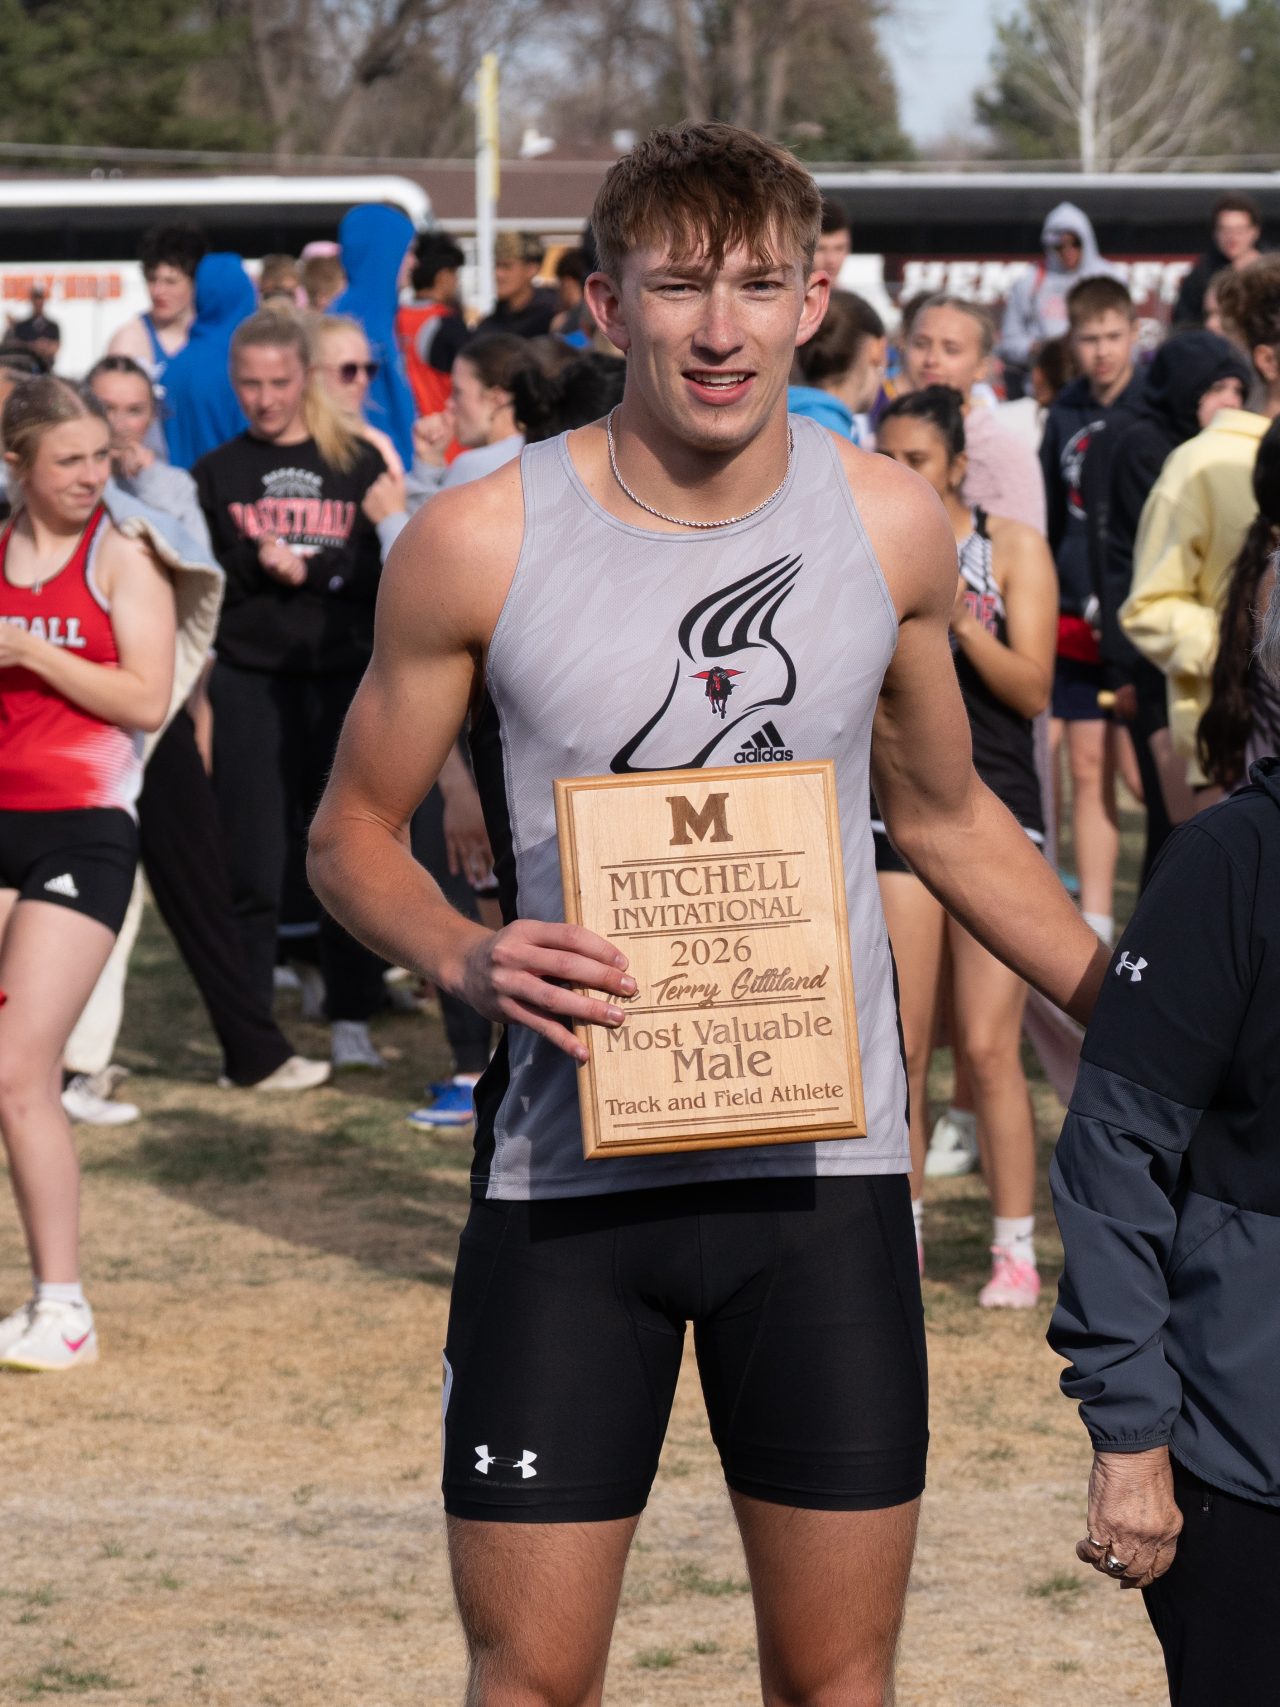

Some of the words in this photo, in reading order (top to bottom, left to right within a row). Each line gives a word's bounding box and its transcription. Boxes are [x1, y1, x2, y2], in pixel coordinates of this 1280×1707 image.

[734, 748, 793, 763] adidas
[665, 793, 733, 846] M
[608, 860, 800, 902] MITCHELL
[612, 895, 802, 931] INVITATIONAL
[671, 936, 752, 967] 2026
[651, 973, 721, 1008] Terry
[605, 1022, 683, 1053] Most
[692, 1011, 833, 1045] Valuable
[671, 1044, 773, 1083] Male
[605, 1095, 661, 1116] Track
[668, 1091, 706, 1111] and
[714, 1086, 764, 1108] Field
[771, 1083, 844, 1103] Athlete
